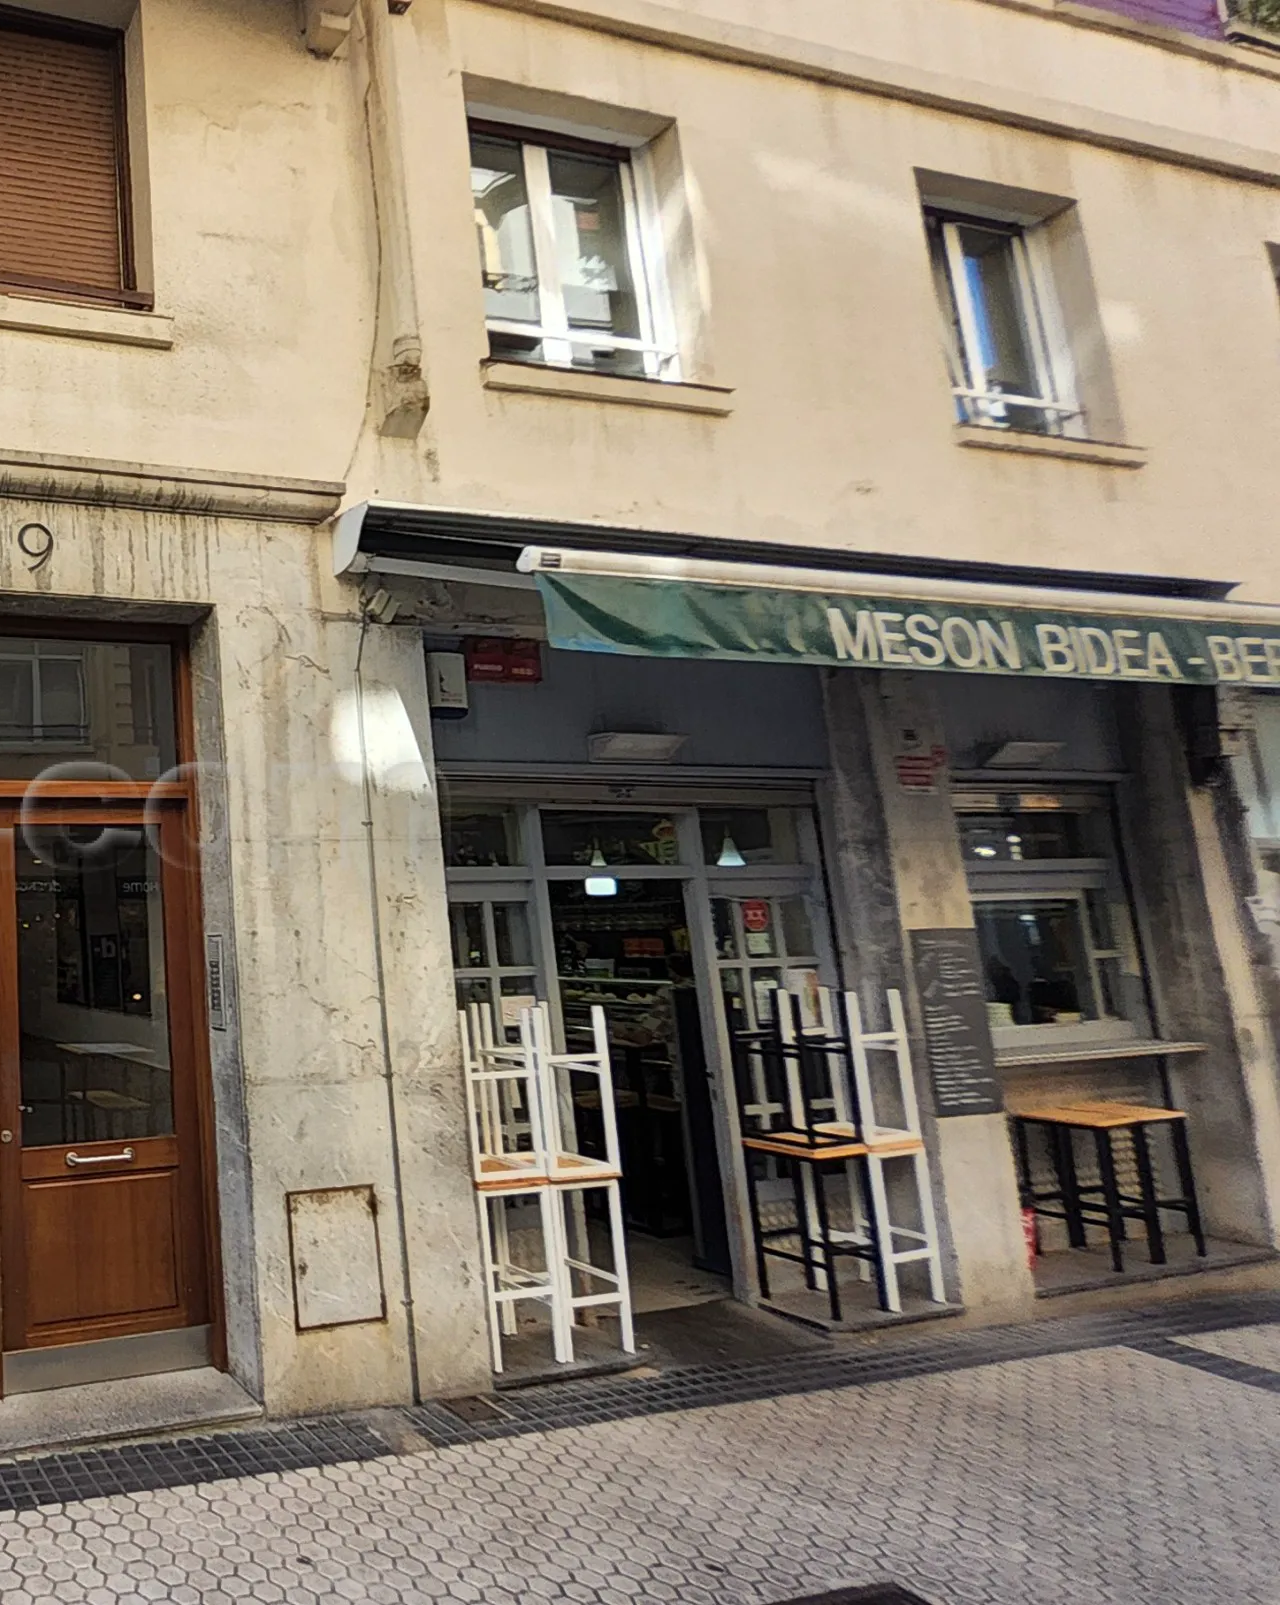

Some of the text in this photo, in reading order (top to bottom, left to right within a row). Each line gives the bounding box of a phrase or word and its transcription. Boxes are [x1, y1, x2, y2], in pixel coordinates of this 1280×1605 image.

[17, 522, 54, 574] 9
[826, 607, 1022, 669] MESON
[1036, 624, 1183, 680] BIDEA
